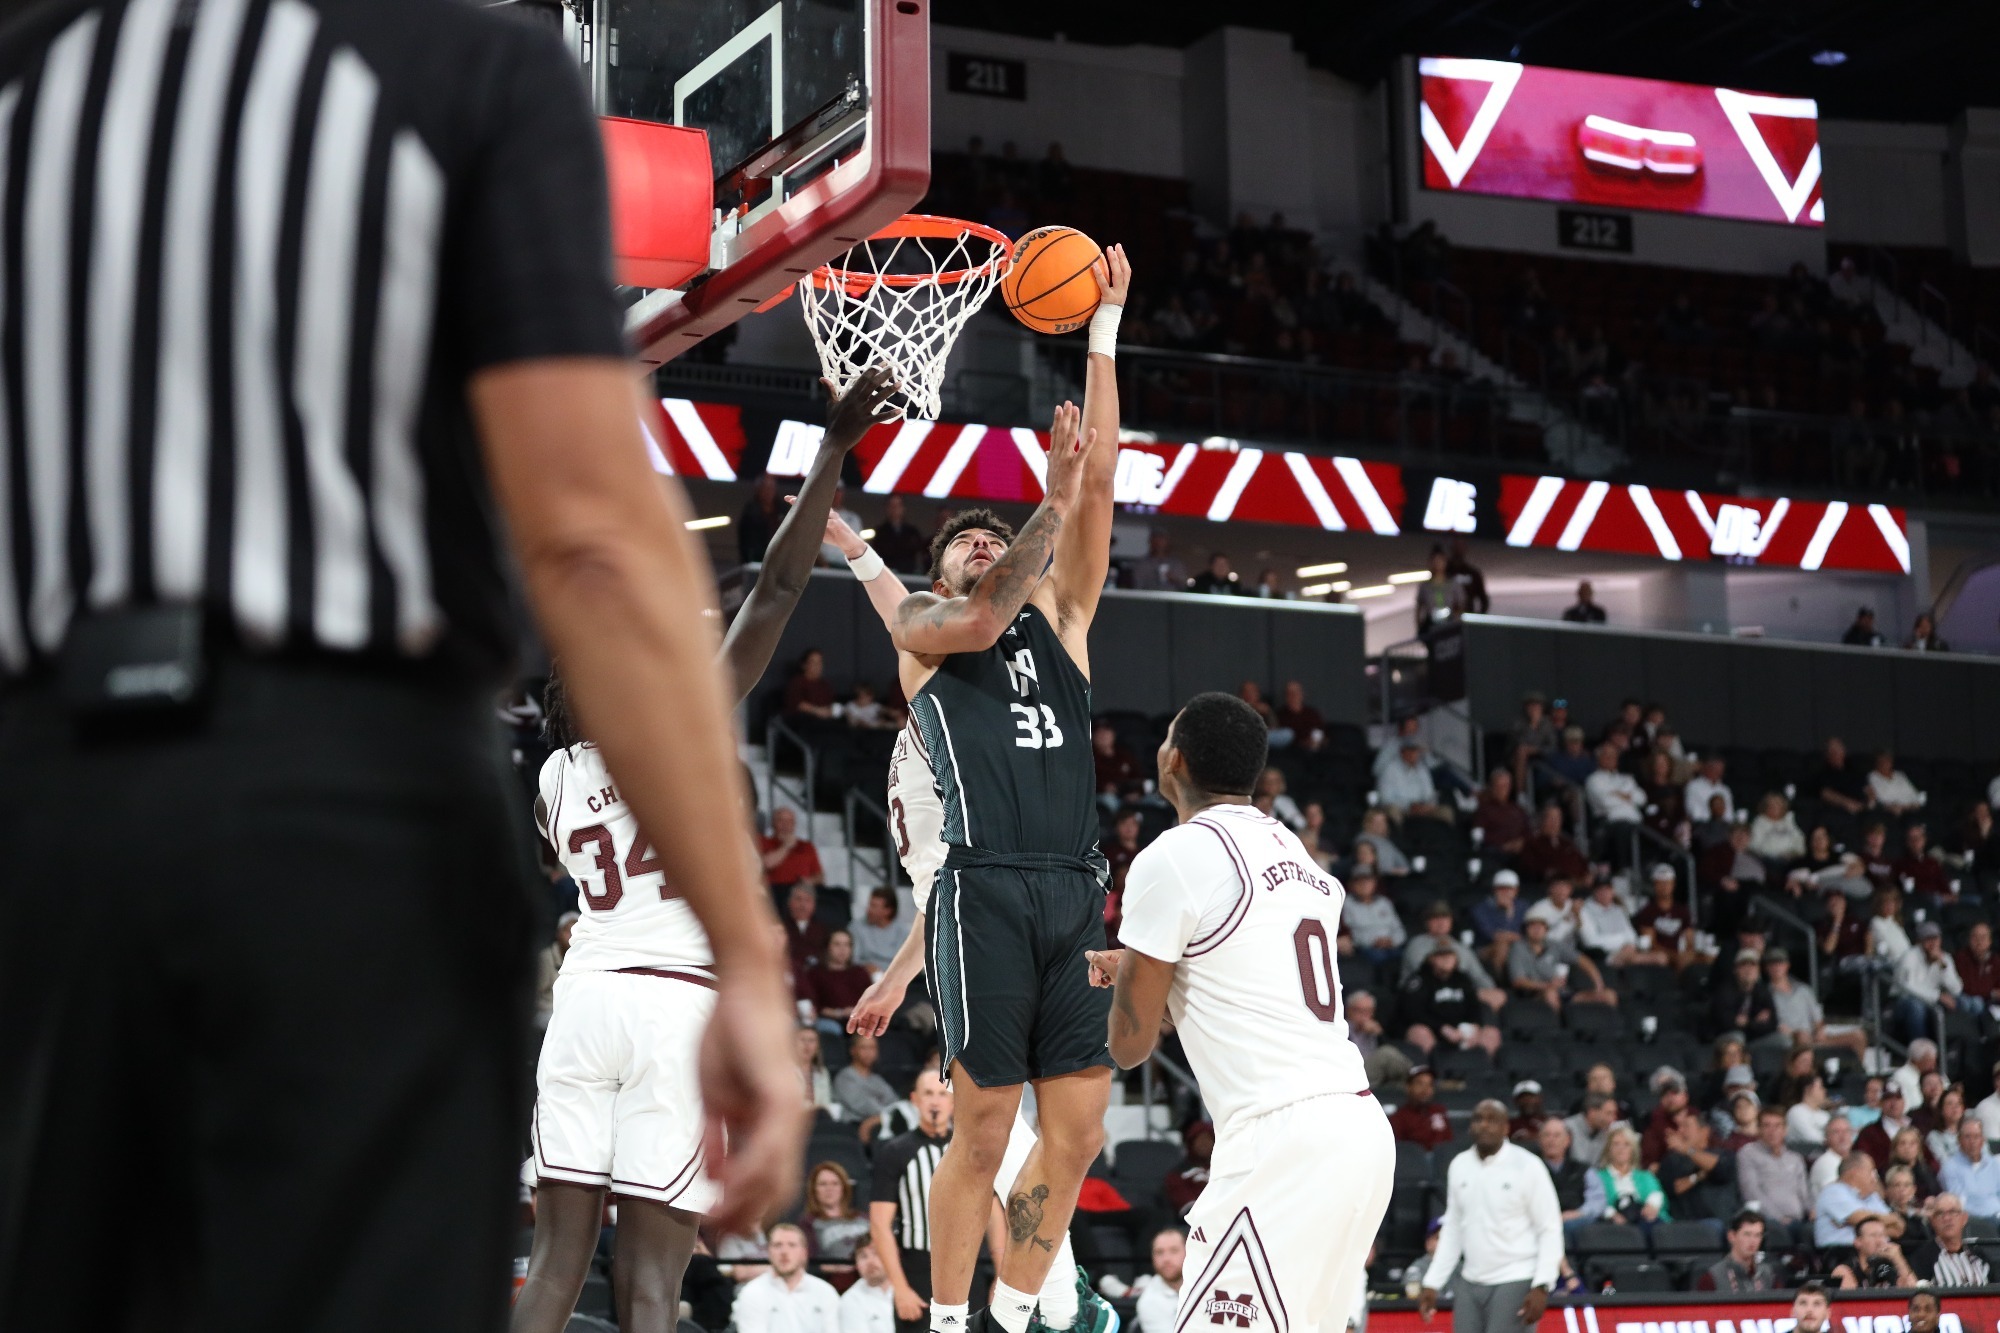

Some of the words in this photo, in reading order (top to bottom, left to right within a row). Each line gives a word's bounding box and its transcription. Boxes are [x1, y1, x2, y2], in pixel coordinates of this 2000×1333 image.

[966, 62, 1006, 92] 211
[1573, 215, 1617, 246] 212
[1114, 448, 1165, 506] DE
[1423, 477, 1477, 533] DE
[1710, 503, 1762, 557] DE
[1010, 702, 1063, 749] 33
[586, 785, 619, 813] CH
[1261, 860, 1331, 896] JEFFRIES
[1292, 917, 1336, 1023] 0
[1214, 1301, 1249, 1316] STATE
